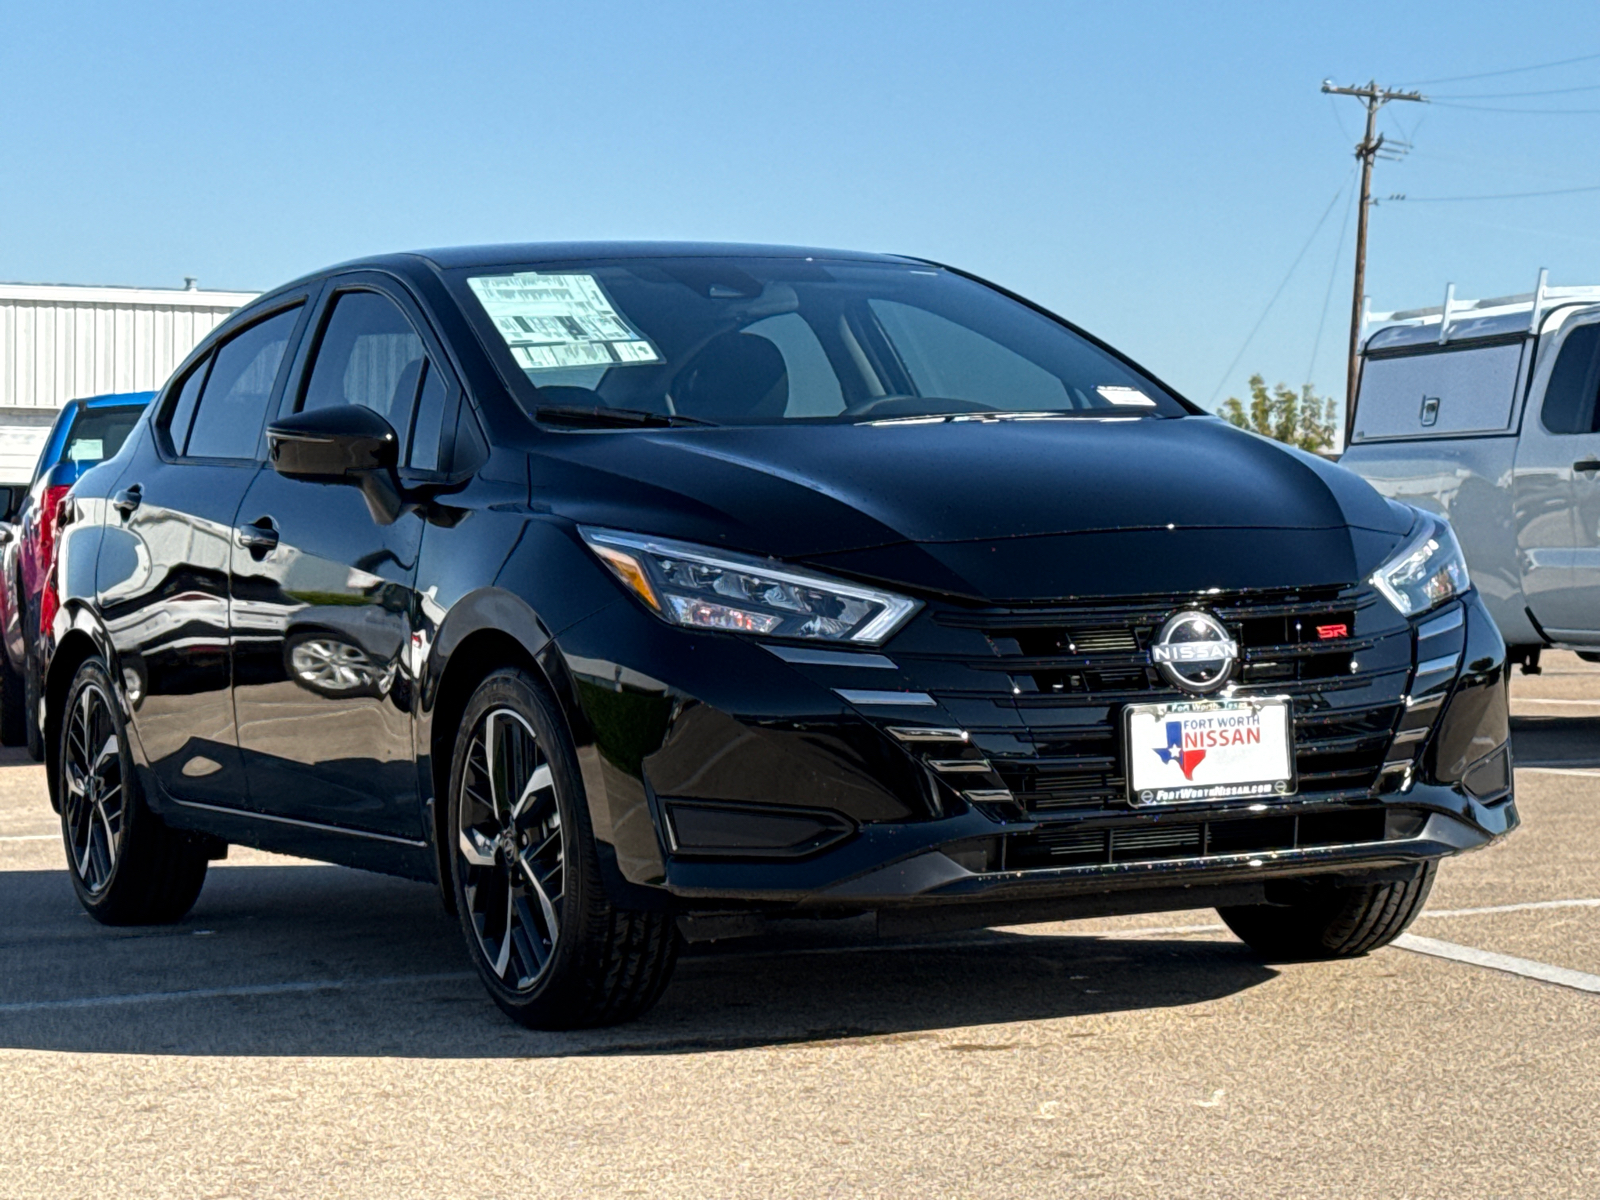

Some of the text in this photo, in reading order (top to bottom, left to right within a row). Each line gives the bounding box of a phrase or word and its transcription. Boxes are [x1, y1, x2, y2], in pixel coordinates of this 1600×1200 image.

[1316, 624, 1348, 639] SR
[1154, 643, 1236, 660] NISSAN
[1183, 715, 1260, 730] FORT WORTH
[1184, 727, 1260, 748] NISSAN
